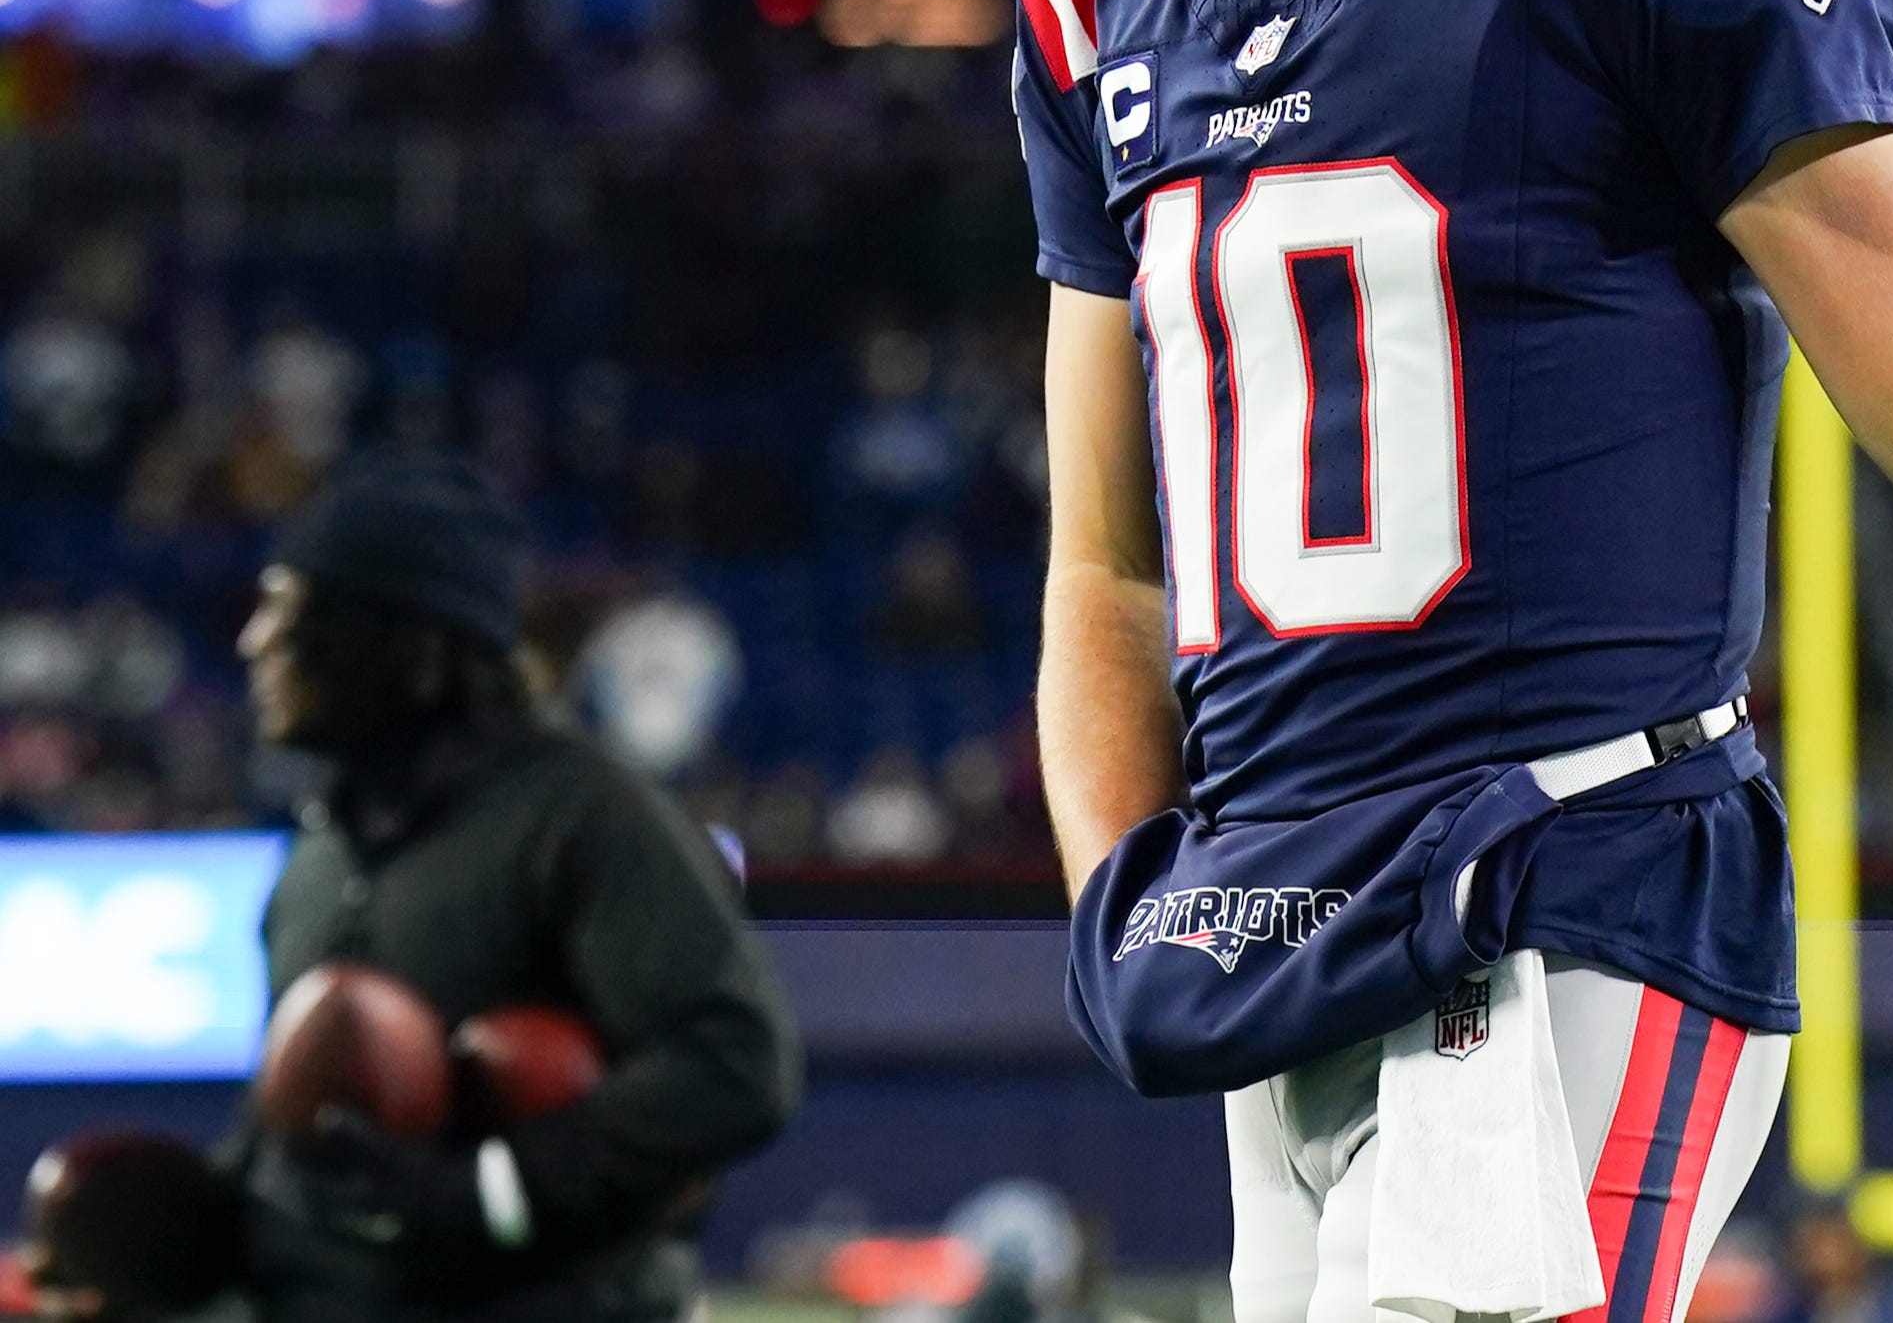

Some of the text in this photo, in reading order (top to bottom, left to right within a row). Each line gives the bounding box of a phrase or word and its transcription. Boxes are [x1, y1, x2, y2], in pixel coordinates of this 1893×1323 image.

[1101, 61, 1151, 148] C
[1205, 90, 1312, 149] PATRIOTS
[1137, 157, 1471, 653] 10
[1112, 886, 1353, 963] PATRIOTS
[1440, 1009, 1485, 1051] NFL
